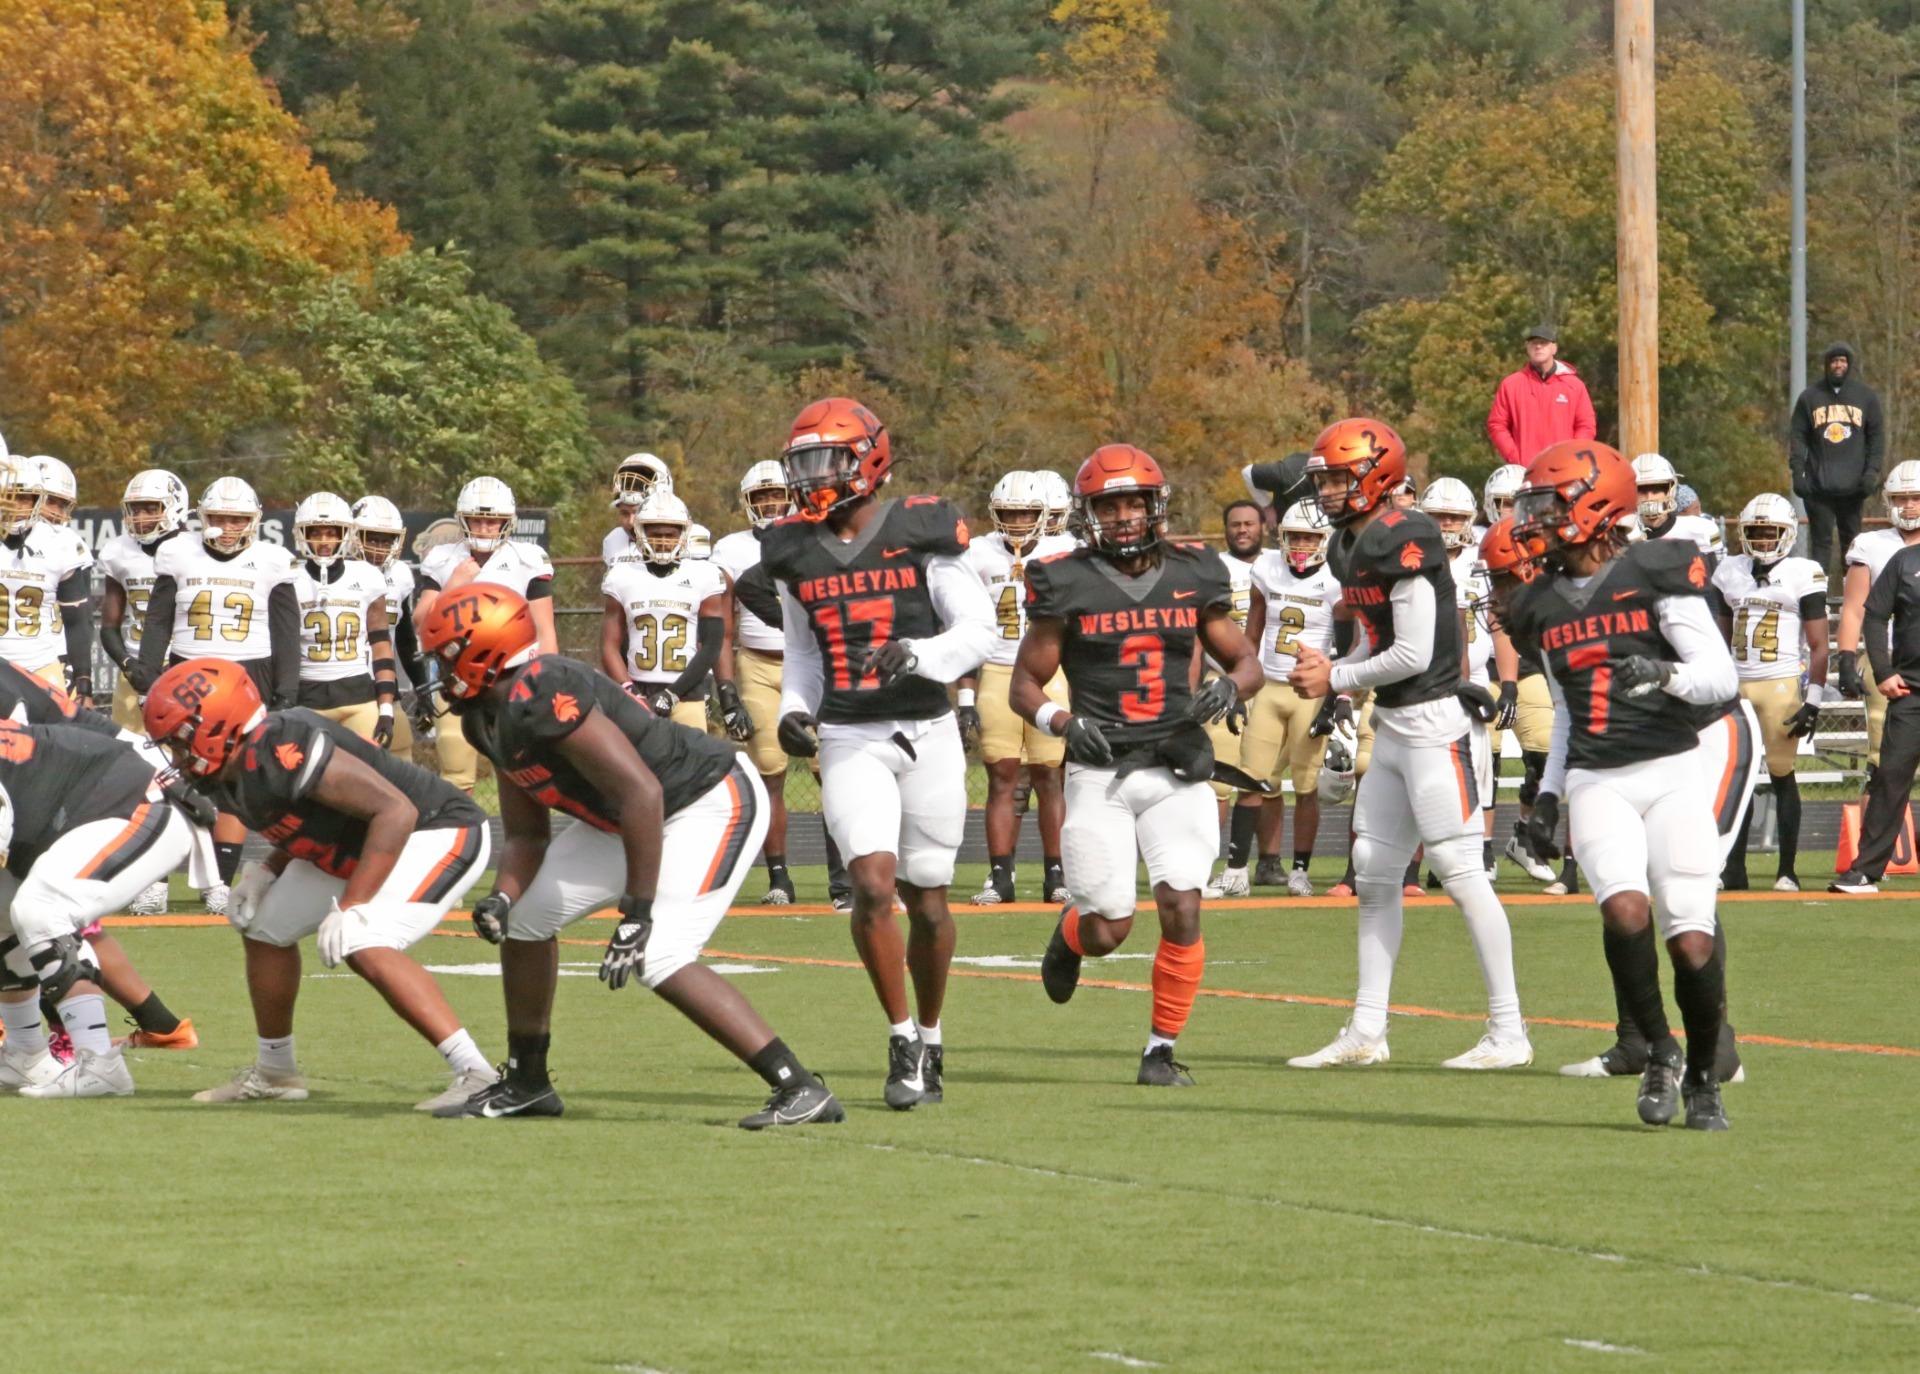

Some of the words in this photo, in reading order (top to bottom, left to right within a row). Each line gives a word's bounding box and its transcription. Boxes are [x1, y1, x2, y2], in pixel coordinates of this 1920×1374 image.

[1361, 429, 1385, 454] 2
[799, 566, 917, 602] WESLEYAN
[187, 589, 254, 642] 43
[303, 611, 361, 662] 30
[441, 595, 482, 632] 77
[1078, 608, 1198, 634] WESLEYAN
[1274, 606, 1305, 655] 2
[633, 613, 688, 672] 32
[814, 595, 896, 691] 17
[172, 672, 213, 710] 62
[1118, 631, 1166, 722] 3
[1565, 640, 1613, 735] 7
